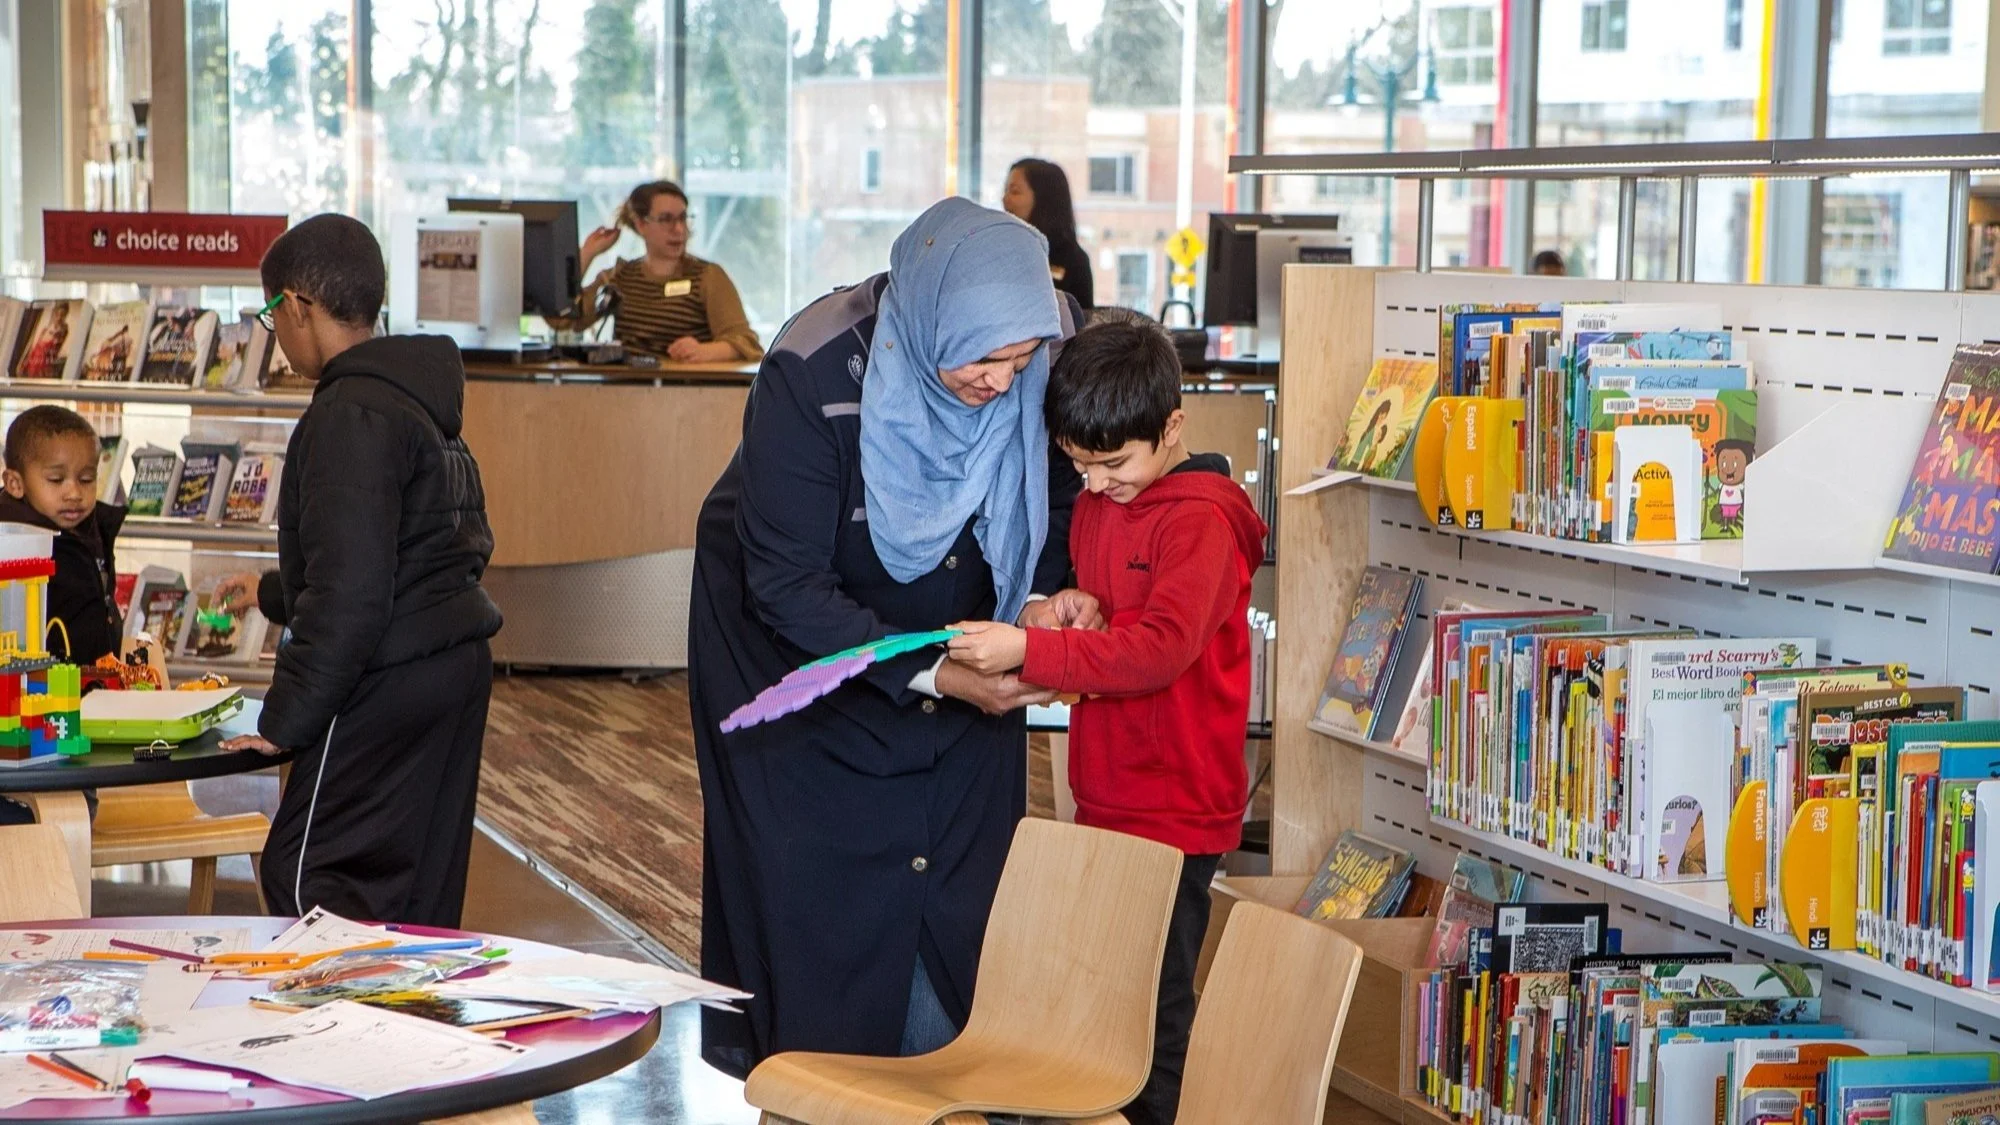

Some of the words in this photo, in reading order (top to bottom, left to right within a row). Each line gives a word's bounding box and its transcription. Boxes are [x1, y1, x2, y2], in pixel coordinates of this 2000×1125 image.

[116, 229, 180, 251] choice
[187, 230, 239, 252] reads
[1465, 405, 1477, 451] Español
[1632, 413, 1710, 433] MONEY
[232, 478, 268, 494] ROBB
[1466, 474, 1475, 506] Spanish
[1923, 484, 2000, 537] MÁS
[1908, 529, 1941, 552] DIJO
[1941, 535, 1957, 553] EL
[1716, 648, 1779, 665] Scarry's
[1651, 667, 1675, 679] Best
[1677, 664, 1713, 680] Word
[1715, 665, 1742, 678] Book
[1652, 688, 1665, 700] El
[1667, 687, 1699, 701] mejor
[1700, 686, 1725, 700] libro
[1863, 699, 1884, 711] BEST
[1753, 788, 1767, 841] Français
[1754, 871, 1763, 903] French
[1809, 897, 1818, 923] Hindi
